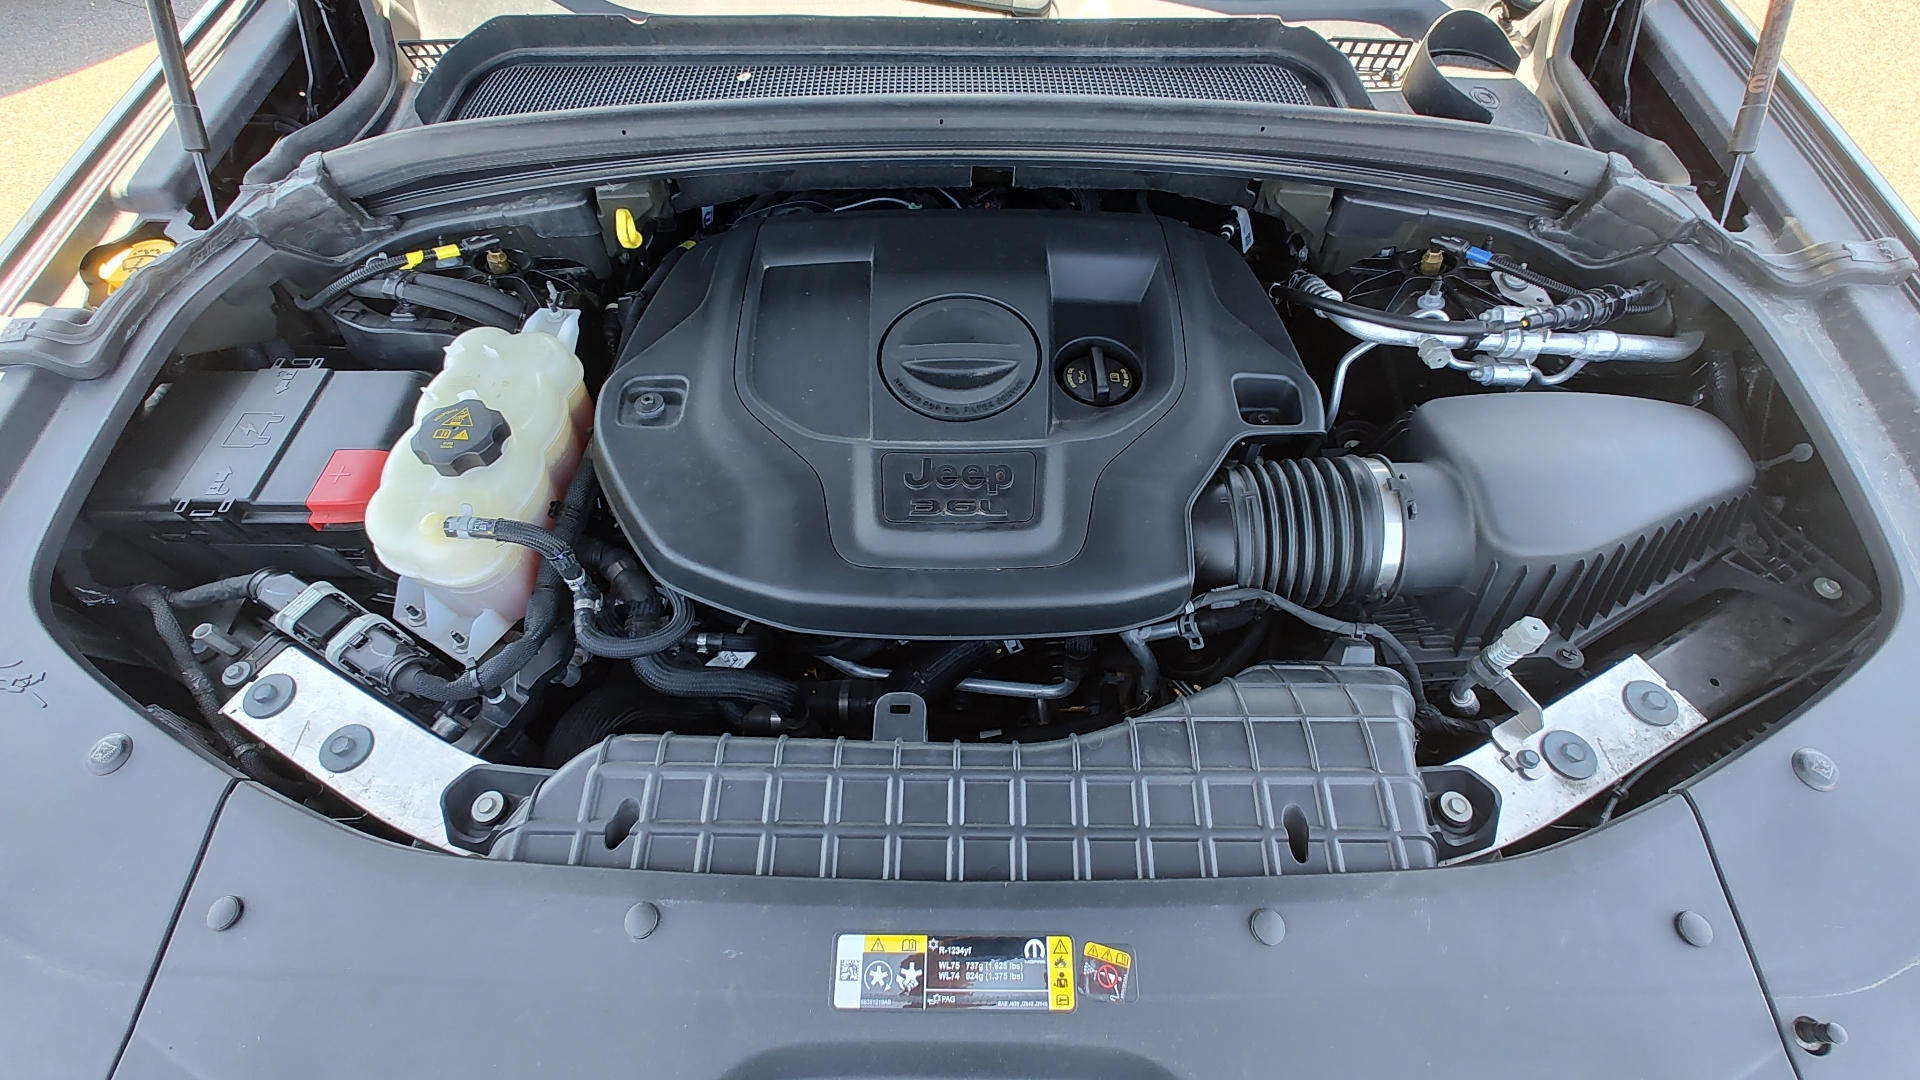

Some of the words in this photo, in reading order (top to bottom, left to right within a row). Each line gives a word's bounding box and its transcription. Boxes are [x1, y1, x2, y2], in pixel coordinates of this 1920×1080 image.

[903, 457, 1014, 496] Jeep
[908, 499, 1008, 517] 3.6L
[938, 946, 972, 957] R-1234yf
[938, 961, 960, 971] WL75
[965, 961, 984, 972] 737g
[985, 961, 1008, 972] (1.625
[1009, 961, 1024, 972] lbs)
[938, 971, 960, 981] WL74
[965, 971, 984, 982] 624g
[985, 971, 1008, 982] (1.375
[1009, 971, 1024, 982] lbs)
[941, 995, 956, 1003] PAG
